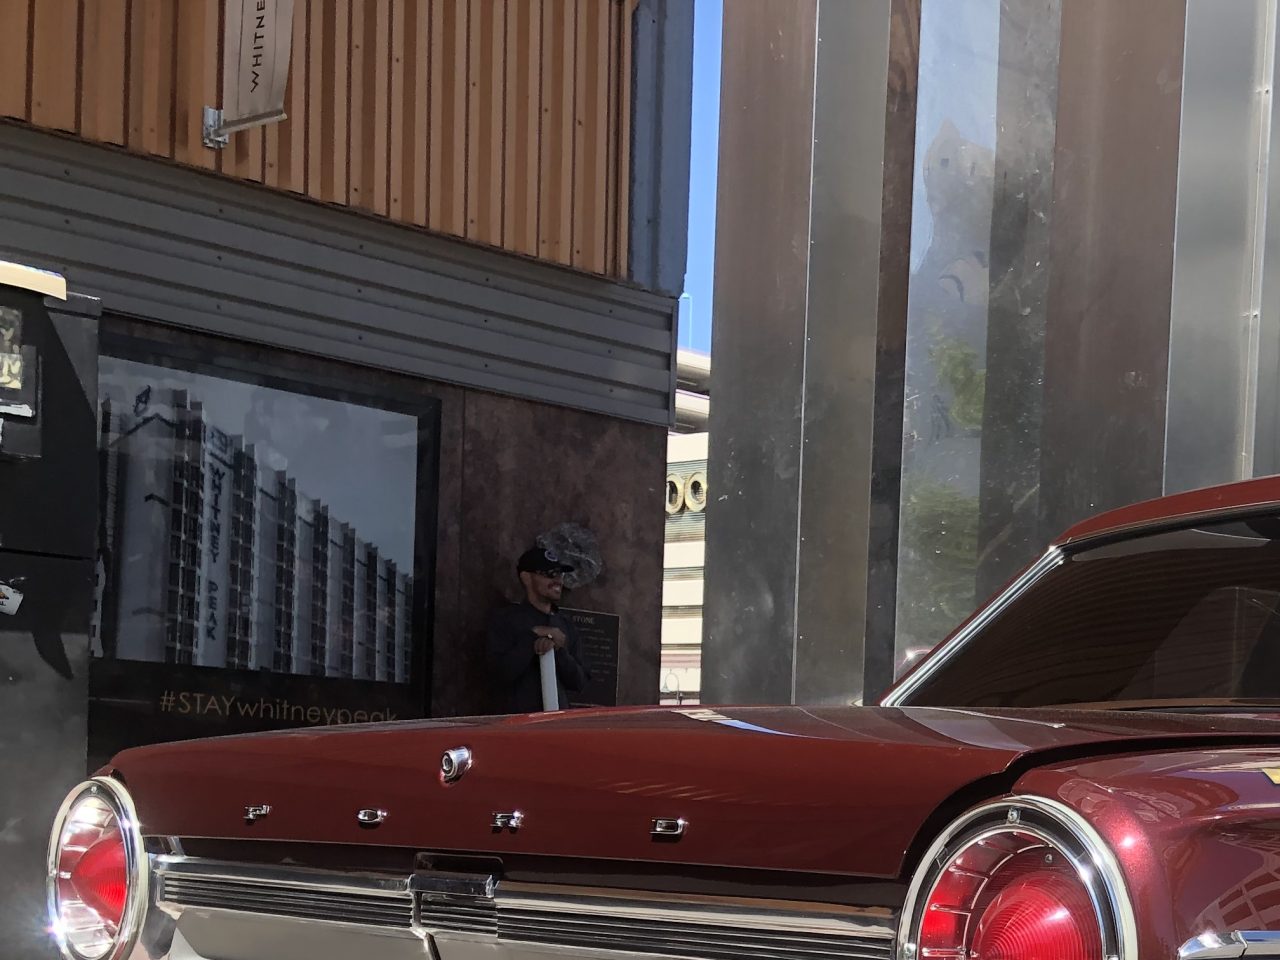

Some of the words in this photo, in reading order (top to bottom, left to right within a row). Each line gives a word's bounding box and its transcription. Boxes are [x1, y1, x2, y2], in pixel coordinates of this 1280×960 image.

[250, 0, 265, 93] WHITNE
[208, 462, 226, 564] WHITNEY
[206, 580, 219, 641] PEAK
[243, 804, 690, 836] FORD
